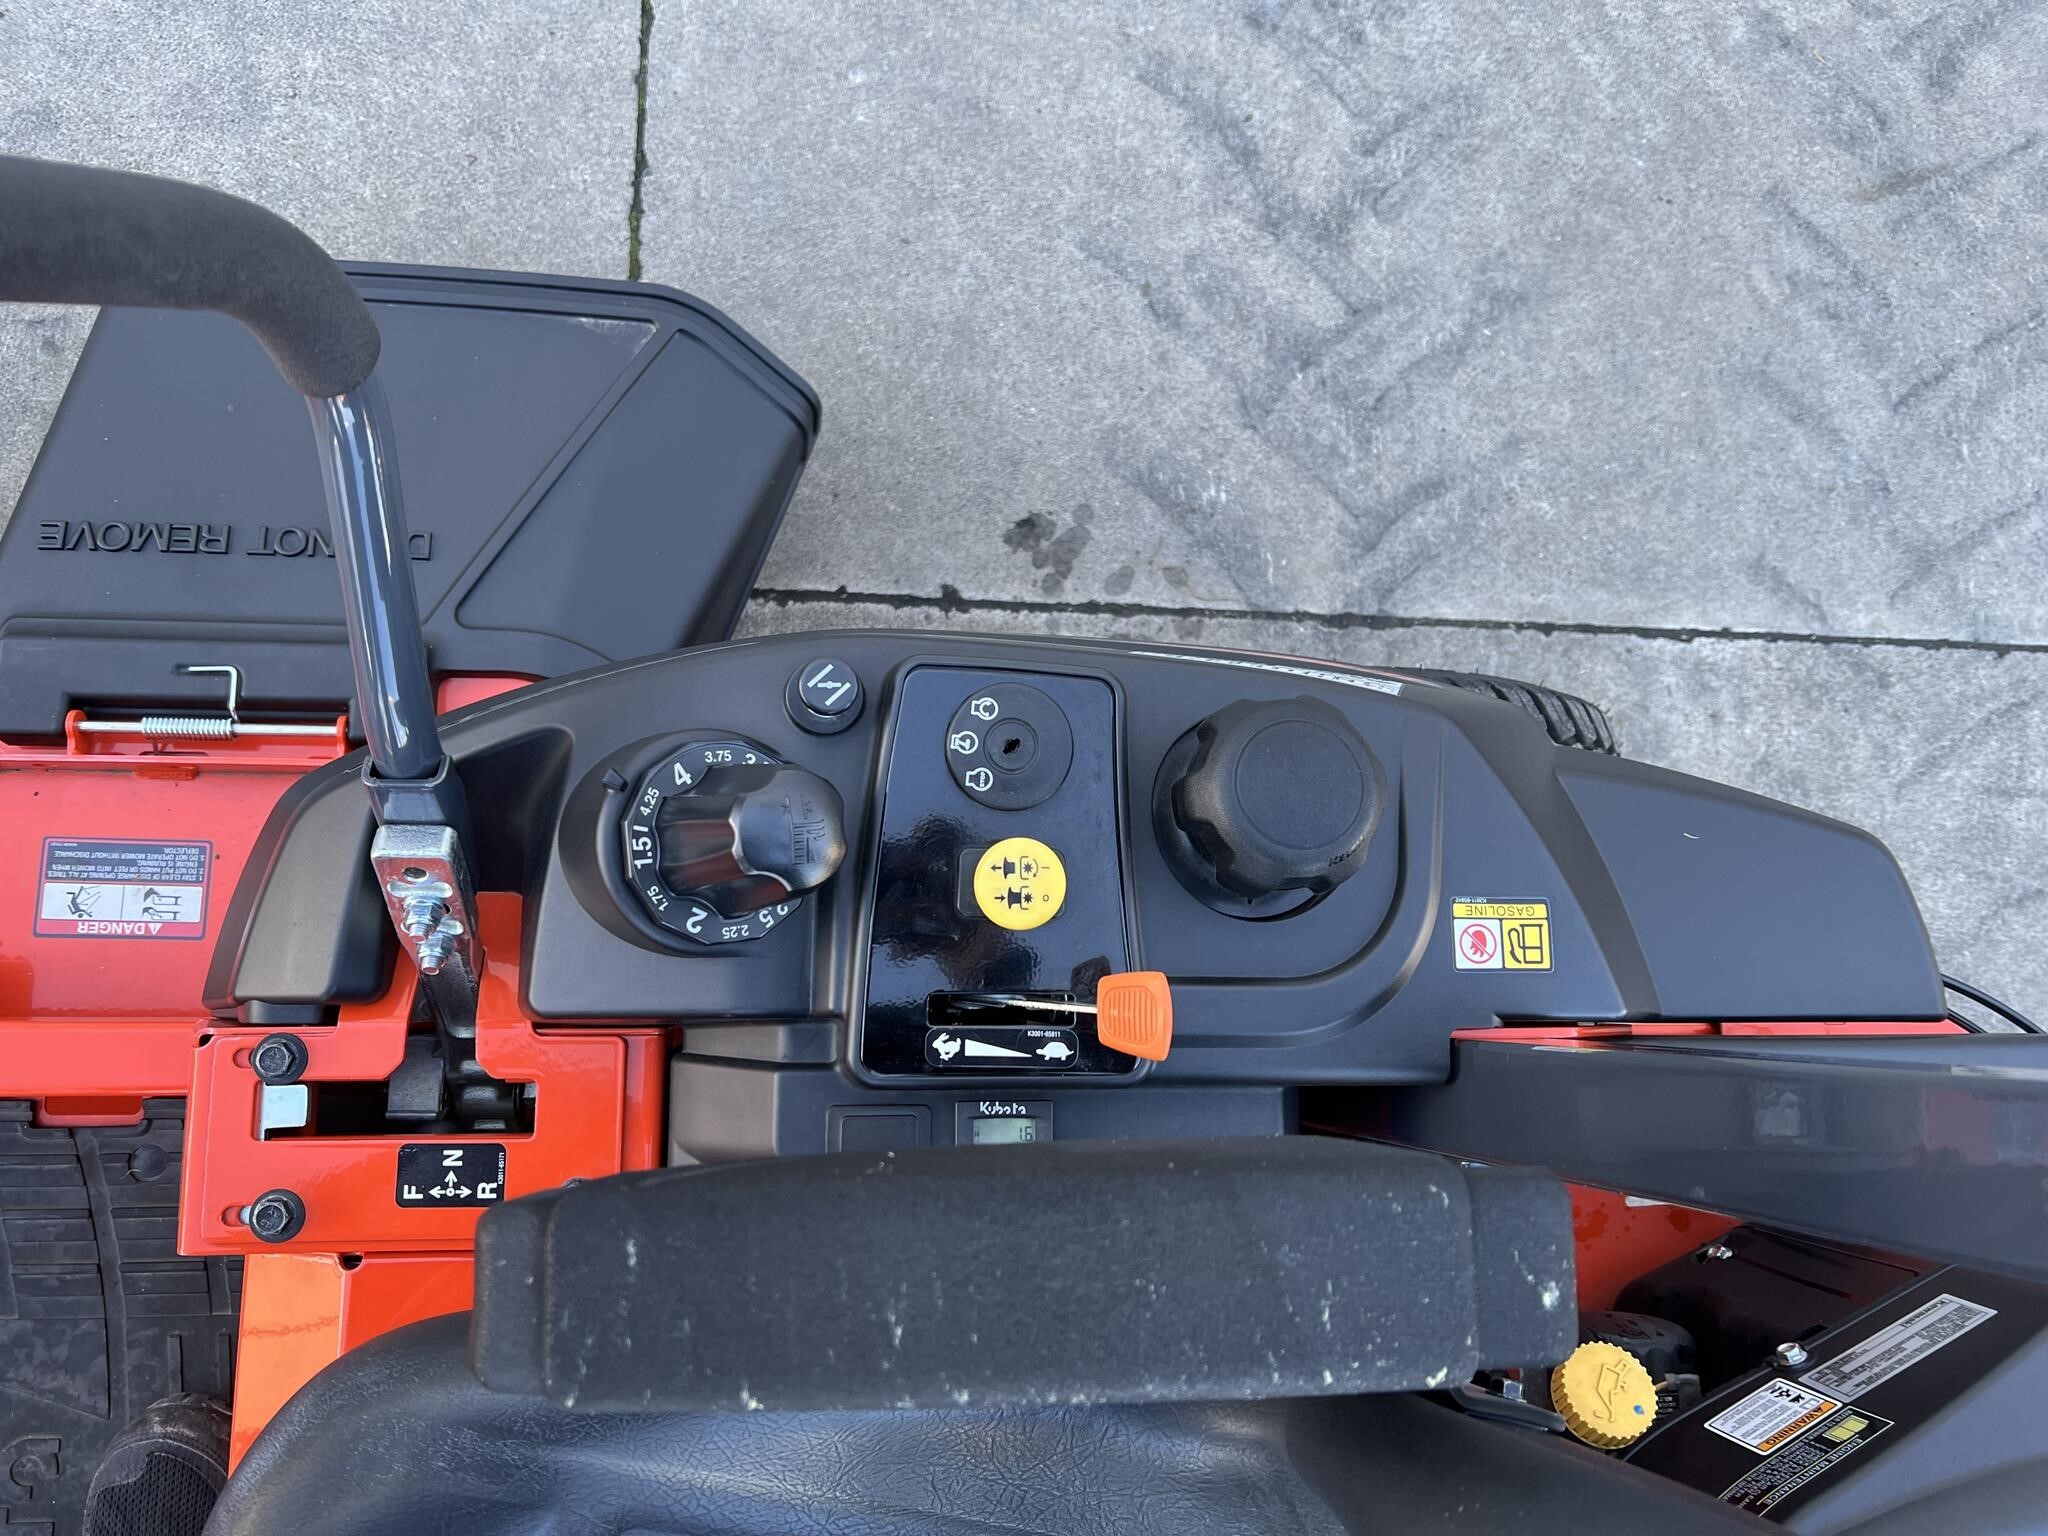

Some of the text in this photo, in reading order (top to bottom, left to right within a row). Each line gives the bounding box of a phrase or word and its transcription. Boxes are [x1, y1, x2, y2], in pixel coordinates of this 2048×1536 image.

[37, 520, 232, 555] REMOVE
[245, 525, 336, 559] NOT
[704, 750, 732, 763] 3.75
[673, 762, 693, 787] 4
[639, 786, 660, 817] 4.25
[646, 885, 670, 912] 1.75
[686, 906, 709, 933] 2
[1465, 905, 1535, 917] GASOLINE
[77, 921, 145, 934] DANGER
[722, 924, 749, 939] 2.25
[979, 1101, 1026, 1115] Kubota
[442, 1149, 463, 1167] N
[403, 1184, 424, 1199] F
[477, 1182, 498, 1199] R
[1764, 1412, 1818, 1446] WARNING
[1761, 1437, 1863, 1505] ENGINE MAINTENANCE
